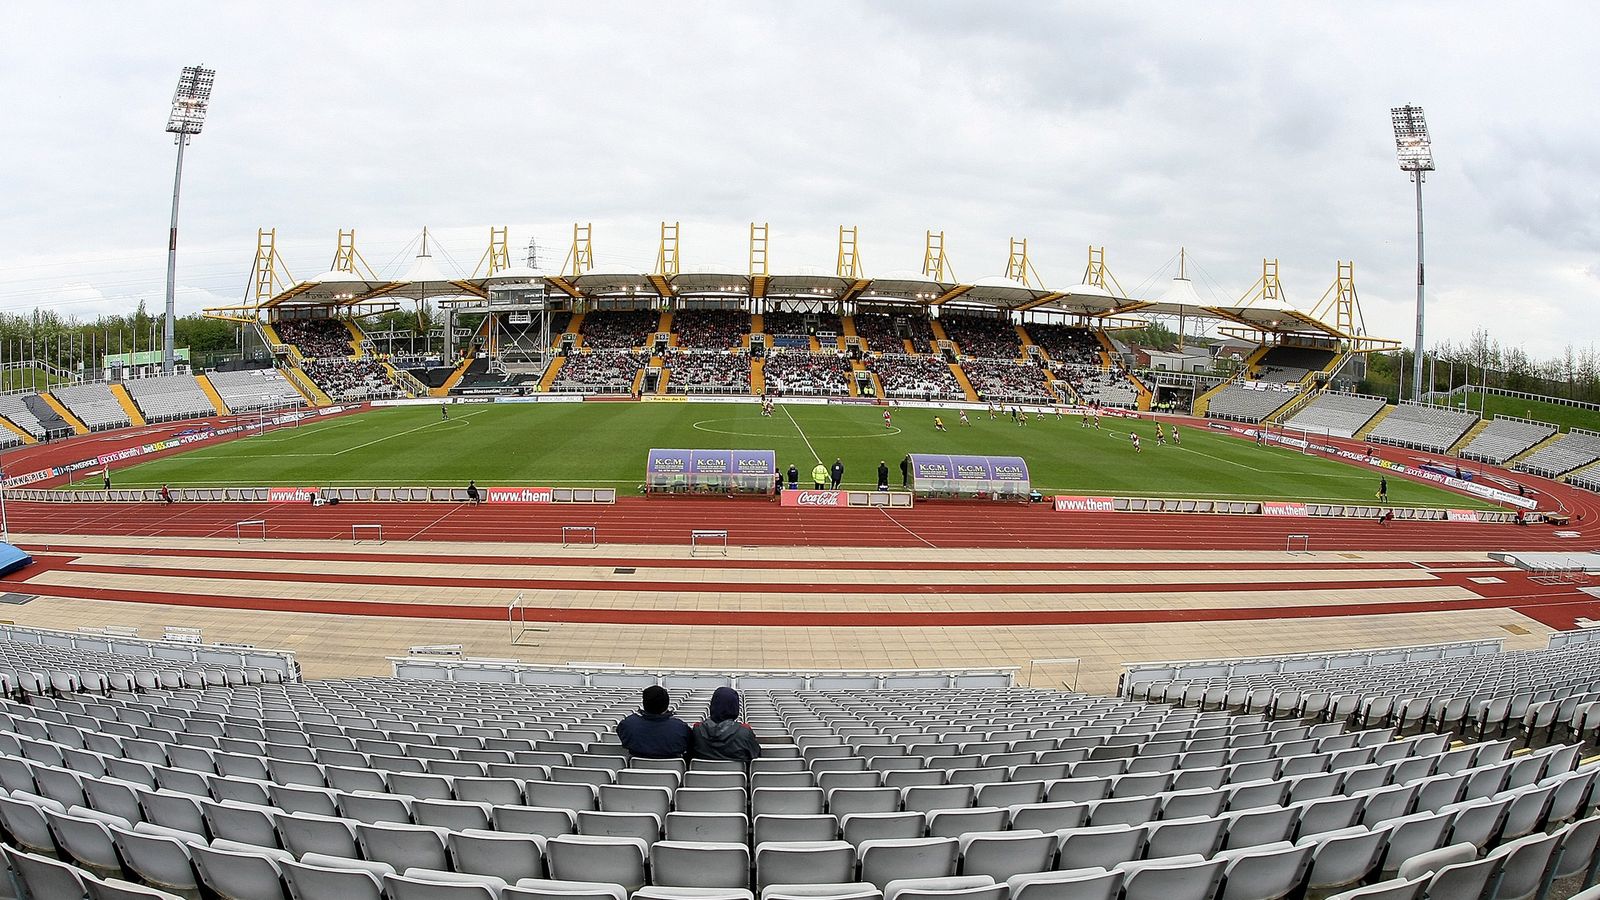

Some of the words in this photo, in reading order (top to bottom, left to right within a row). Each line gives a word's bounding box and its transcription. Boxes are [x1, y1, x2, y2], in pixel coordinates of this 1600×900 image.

[142, 440, 180, 454] bet365.com
[1370, 458, 1404, 472] bet365.com
[798, 491, 839, 506] Coca-Cola
